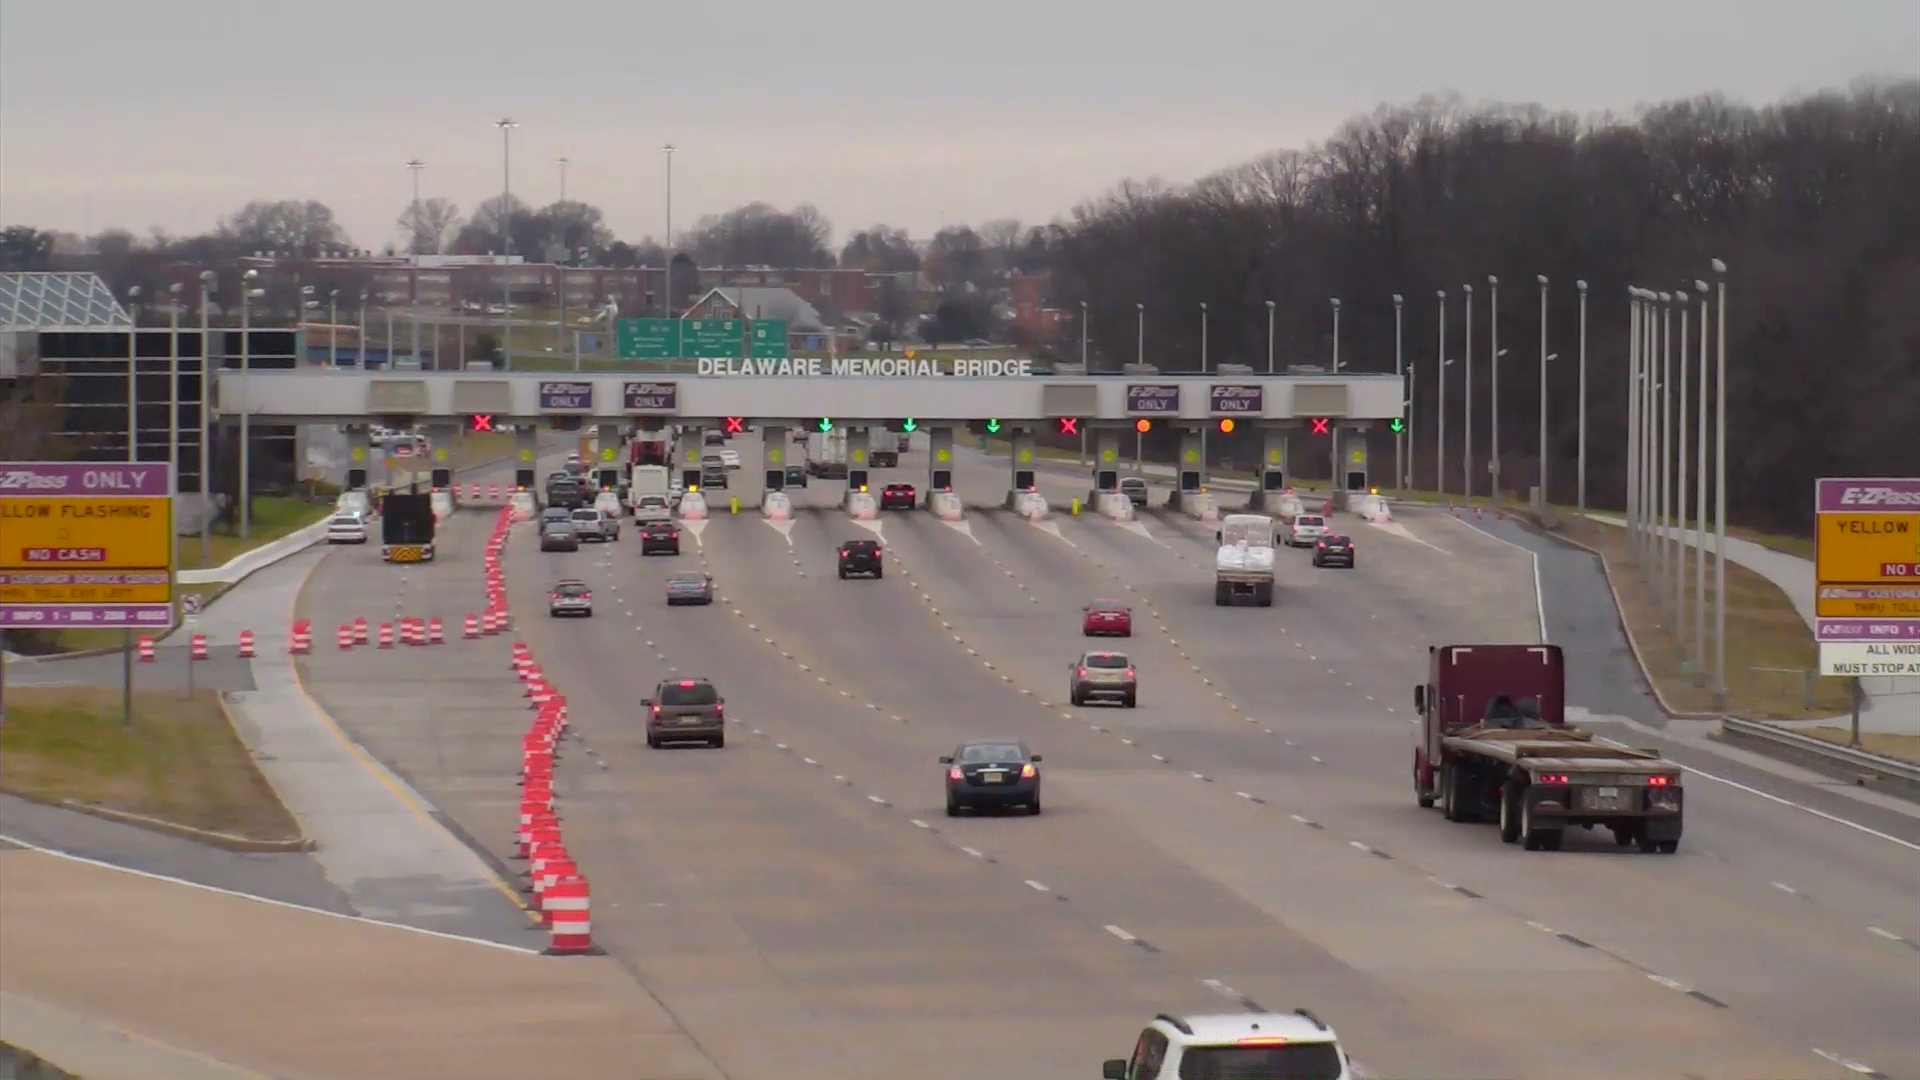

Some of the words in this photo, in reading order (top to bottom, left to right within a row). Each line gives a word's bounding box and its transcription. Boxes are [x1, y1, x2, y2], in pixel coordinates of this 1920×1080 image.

[697, 357, 822, 376] DELAWARE
[831, 358, 944, 377] MEMORIAL
[953, 359, 1033, 377] BRIDGE
[550, 396, 581, 407] ONLY
[634, 396, 665, 407] ONLY
[1137, 399, 1168, 410] ONLY
[1219, 399, 1251, 410] ONLY
[82, 471, 147, 488] ONLY
[61, 505, 151, 518] FLASHING
[1837, 520, 1909, 534] YELLOW
[28, 550, 50, 560] NO
[58, 550, 101, 560] CASH
[1886, 564, 1906, 575] NO
[1869, 625, 1899, 634] INFO
[1867, 645, 1889, 655] ALL
[1833, 663, 1868, 673] MUST
[1872, 663, 1904, 673] STOP
